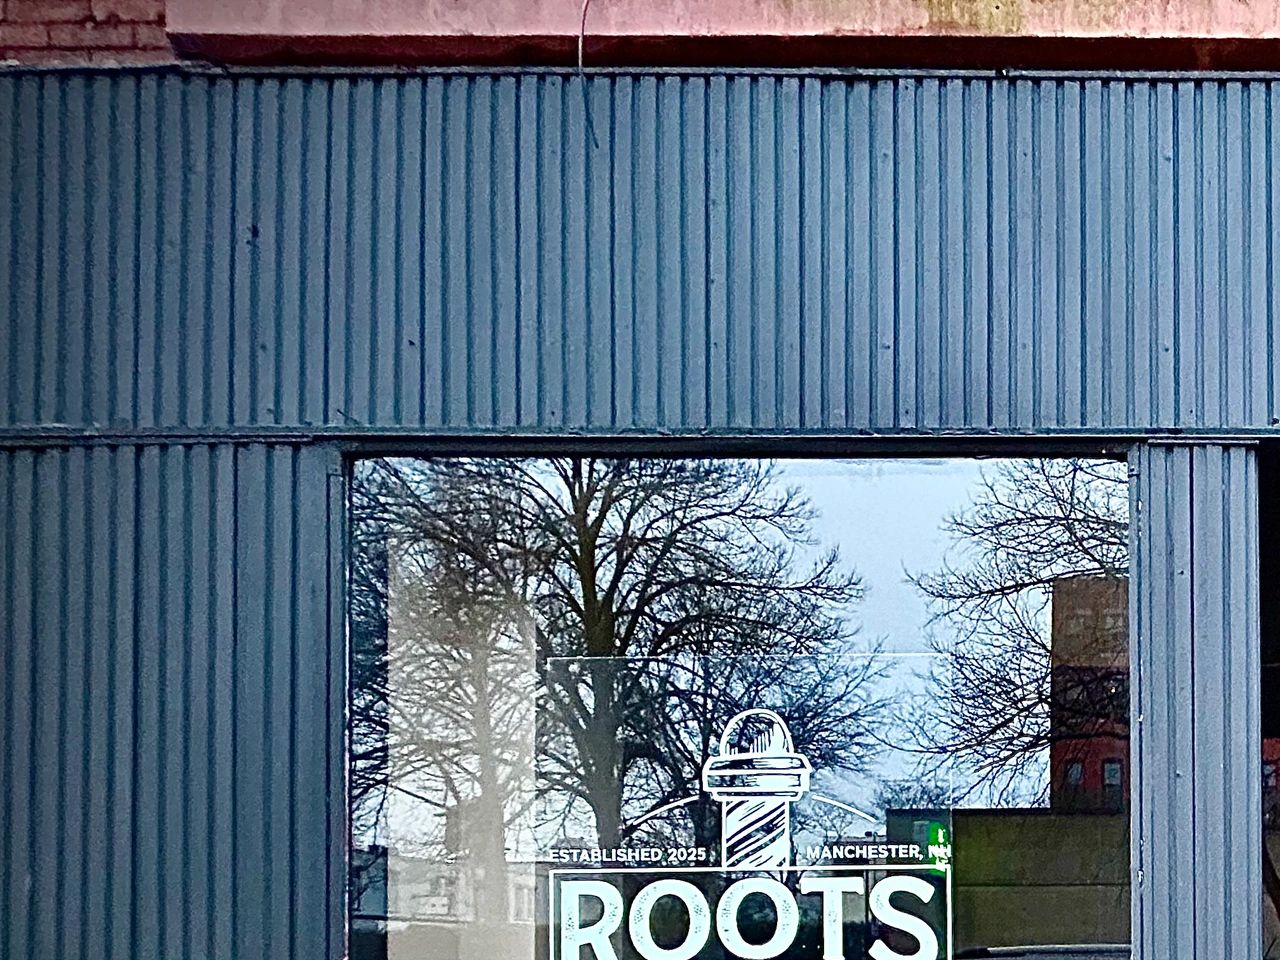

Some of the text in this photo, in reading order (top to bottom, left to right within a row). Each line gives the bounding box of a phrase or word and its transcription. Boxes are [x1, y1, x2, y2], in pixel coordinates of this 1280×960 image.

[550, 848, 706, 862] ESTABLISHED 2025
[807, 844, 924, 860] MANCHESTER,
